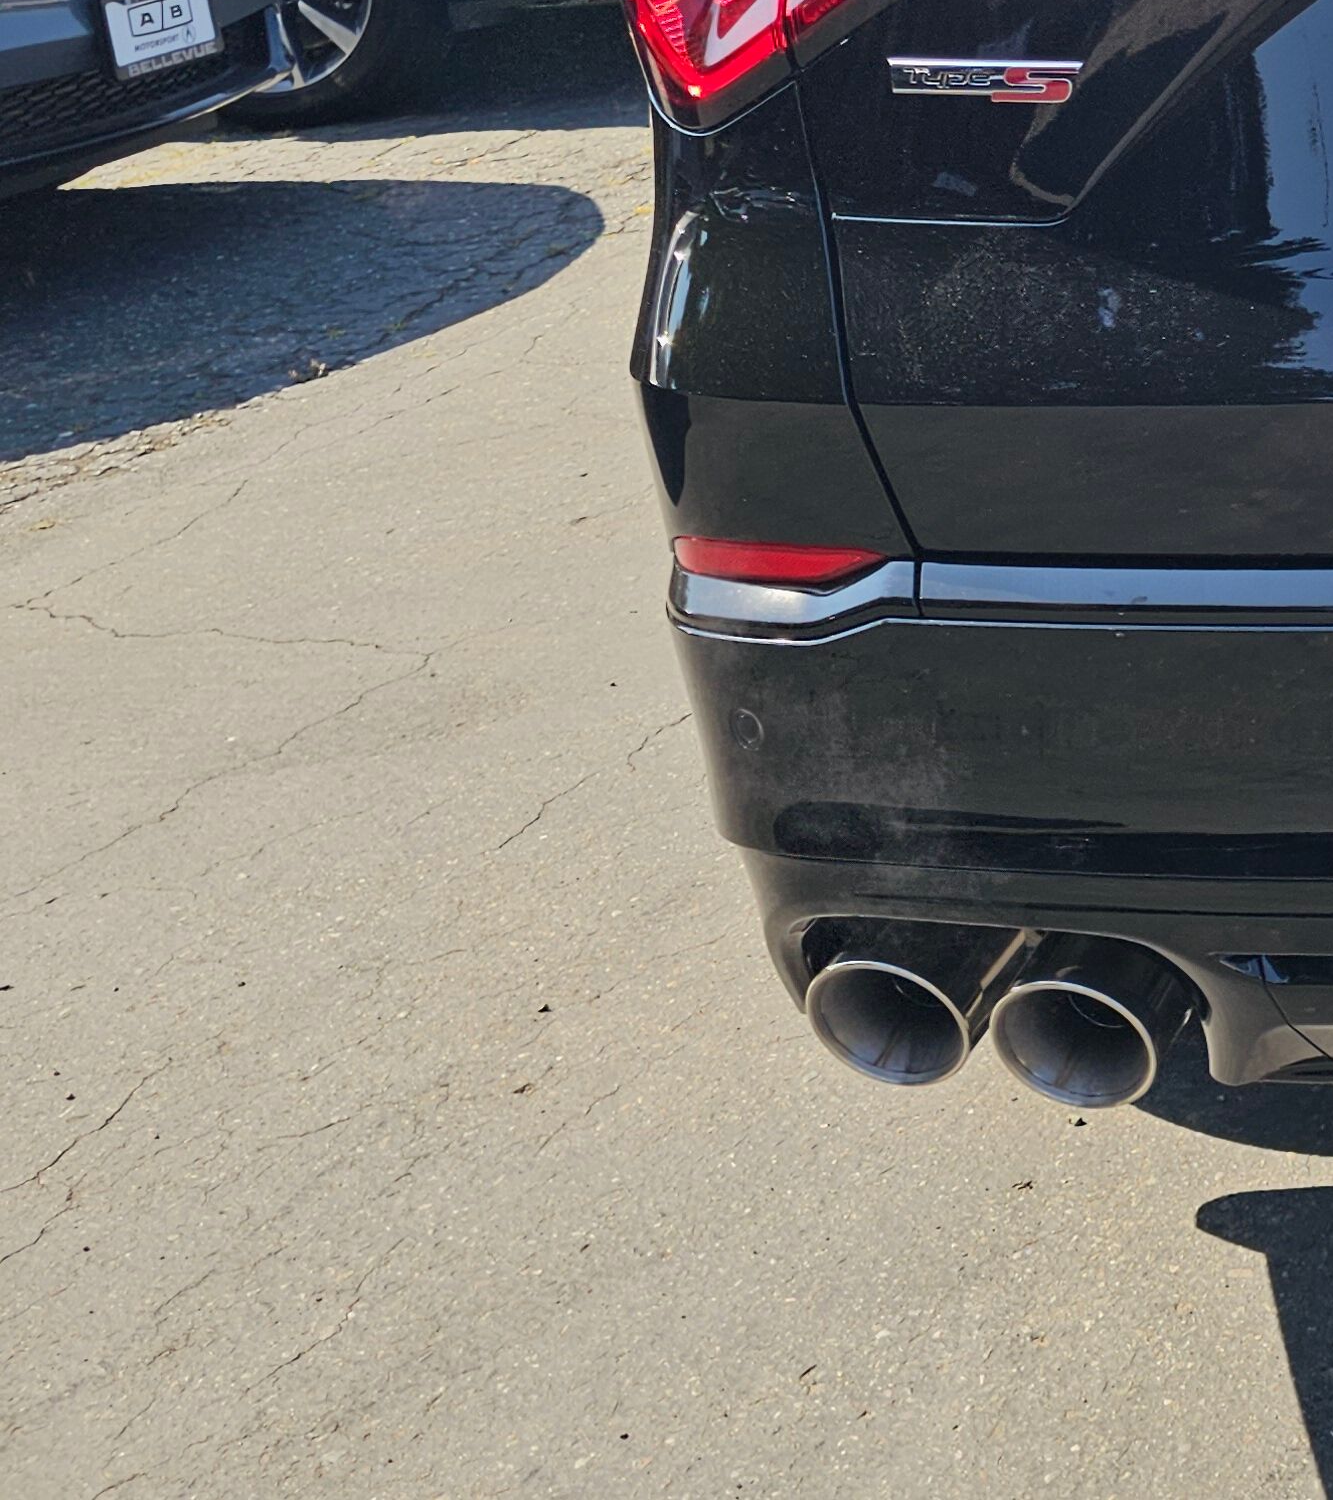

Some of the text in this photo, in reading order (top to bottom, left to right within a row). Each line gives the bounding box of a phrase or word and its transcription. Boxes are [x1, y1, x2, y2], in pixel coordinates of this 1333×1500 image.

[140, 4, 183, 27] A B
[128, 41, 218, 78] BELLEVUE
[991, 66, 1080, 103] S
